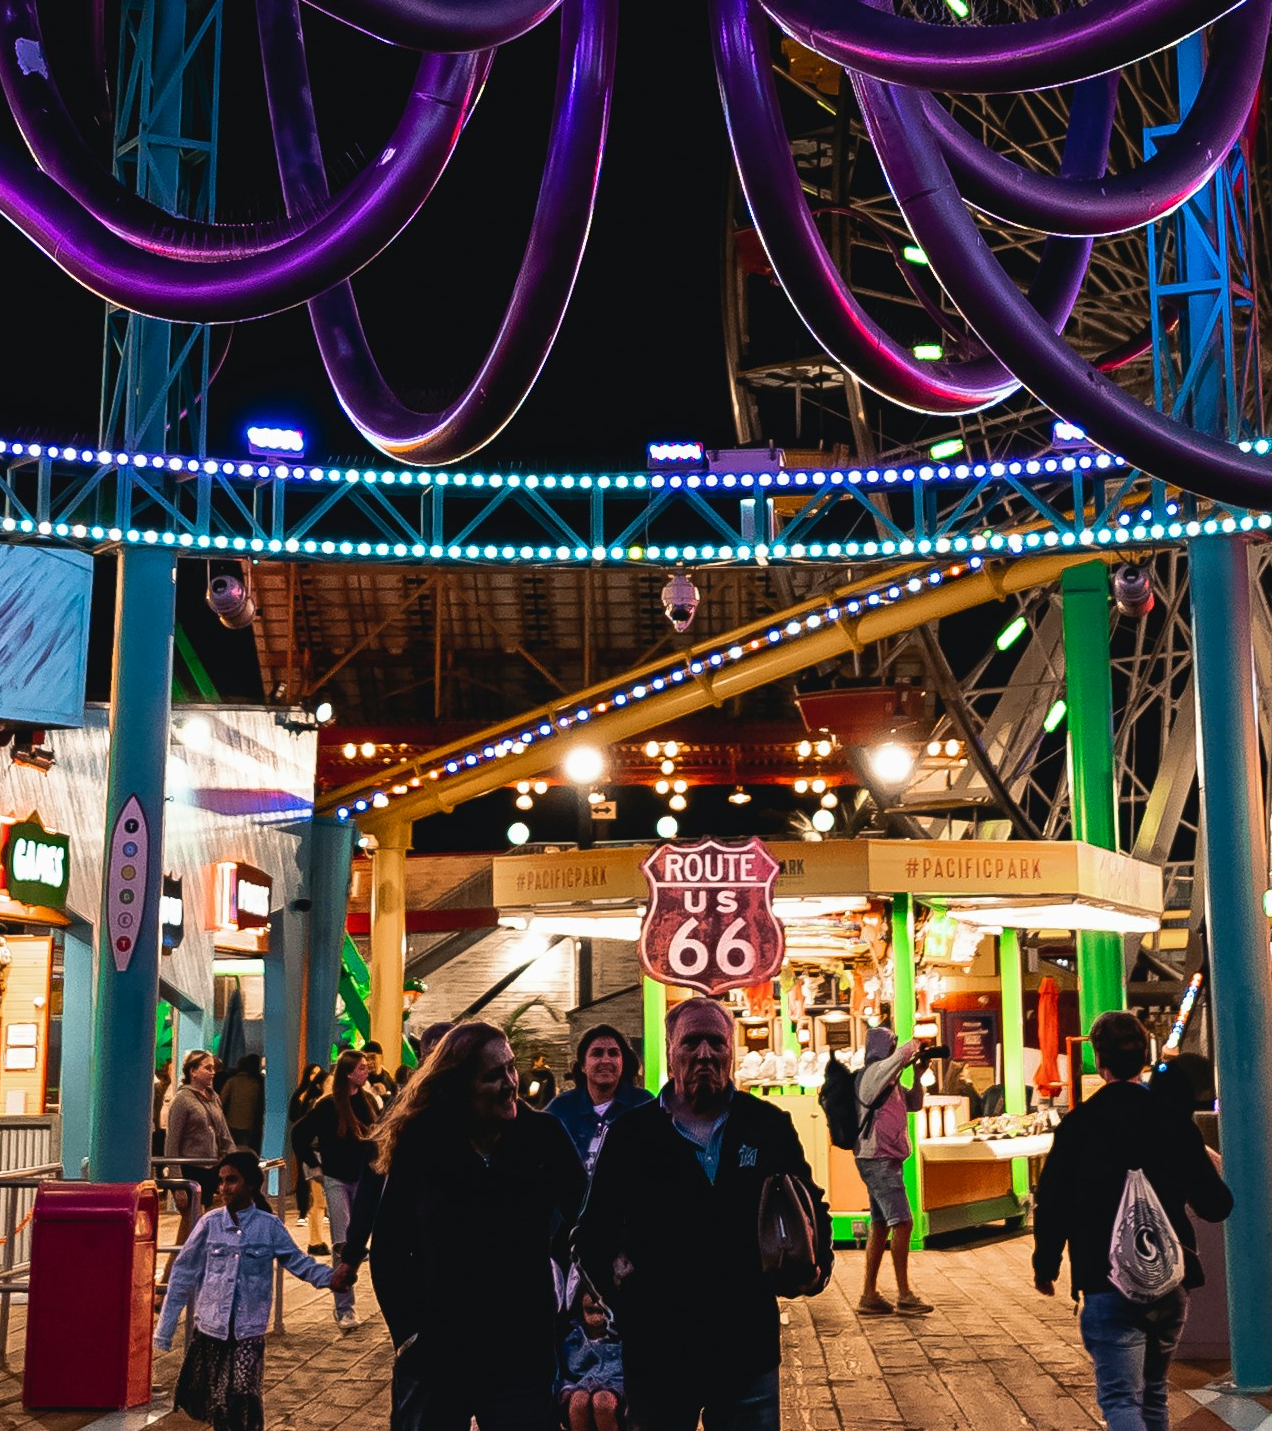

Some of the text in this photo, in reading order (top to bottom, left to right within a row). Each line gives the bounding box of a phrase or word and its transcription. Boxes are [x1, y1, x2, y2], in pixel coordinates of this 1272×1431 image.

[516, 866, 608, 890] #PACIFICPARK
[664, 853, 757, 882] ROUTE
[905, 857, 1042, 880] #PACIFICPARK
[668, 917, 756, 976] 66
